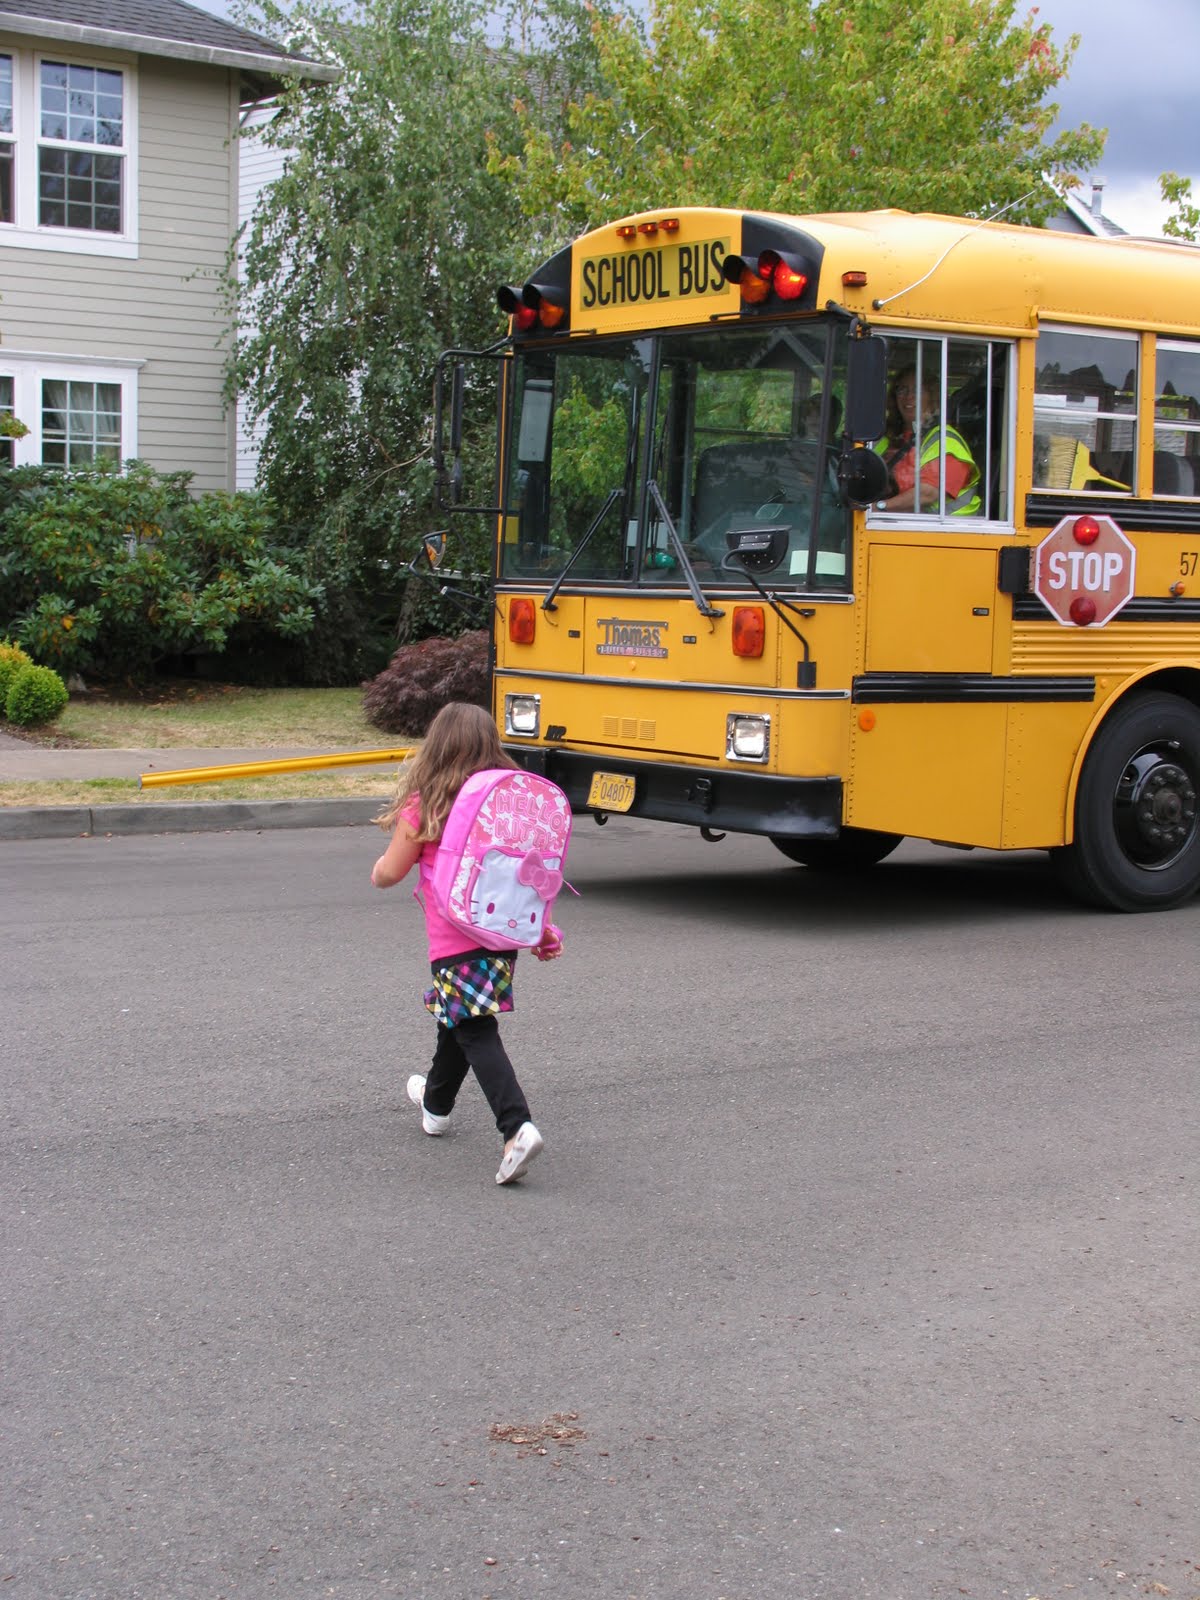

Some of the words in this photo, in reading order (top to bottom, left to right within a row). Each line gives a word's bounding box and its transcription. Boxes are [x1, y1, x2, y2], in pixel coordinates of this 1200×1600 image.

[583, 251, 670, 307] SCHOOL
[679, 241, 725, 295] BUS
[1049, 552, 1123, 591] STOP
[1180, 552, 1198, 576] 57
[597, 617, 668, 647] Thomas
[600, 782, 631, 804] 04807
[496, 792, 565, 832] HELLO
[494, 817, 558, 851] KITTY
